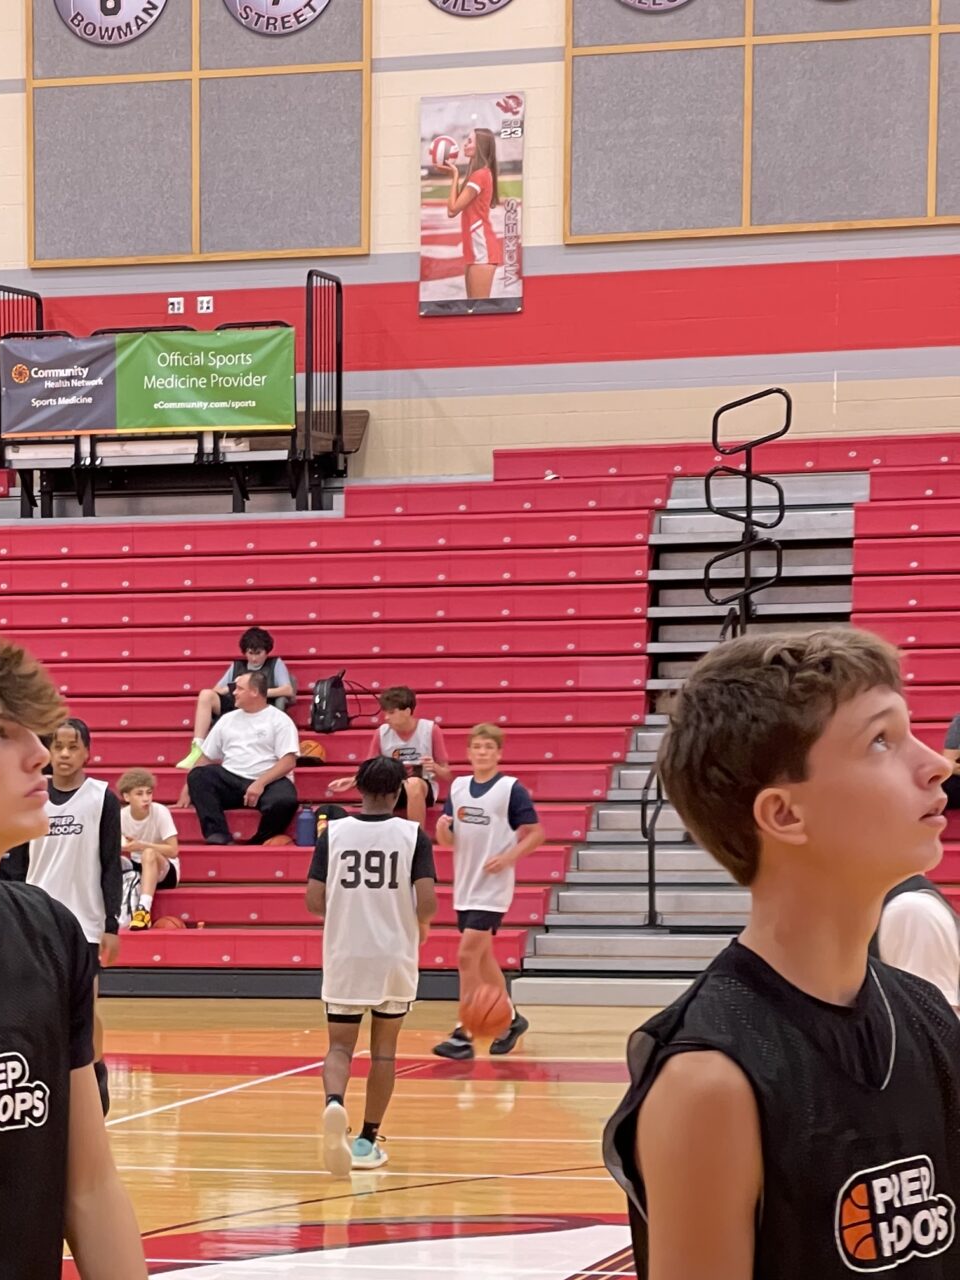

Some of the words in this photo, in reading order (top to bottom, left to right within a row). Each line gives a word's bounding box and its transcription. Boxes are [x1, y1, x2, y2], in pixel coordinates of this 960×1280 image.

[70, 0, 159, 40] BOWMAN
[239, 0, 317, 31] STREET
[501, 128, 521, 138] 23
[503, 198, 519, 287] VICKERS
[157, 352, 204, 367] Official
[208, 351, 252, 368] Sports
[31, 366, 89, 378] Community
[144, 374, 207, 389] Medicine
[210, 372, 267, 388] Provider
[44, 380, 70, 389] Health
[71, 377, 103, 387] Network
[31, 398, 57, 407] Sports
[58, 396, 93, 405] Medicine
[154, 400, 256, 410] eCommunity.com/sports
[340, 850, 399, 889] 391
[879, 1205, 948, 1257] HOOS
